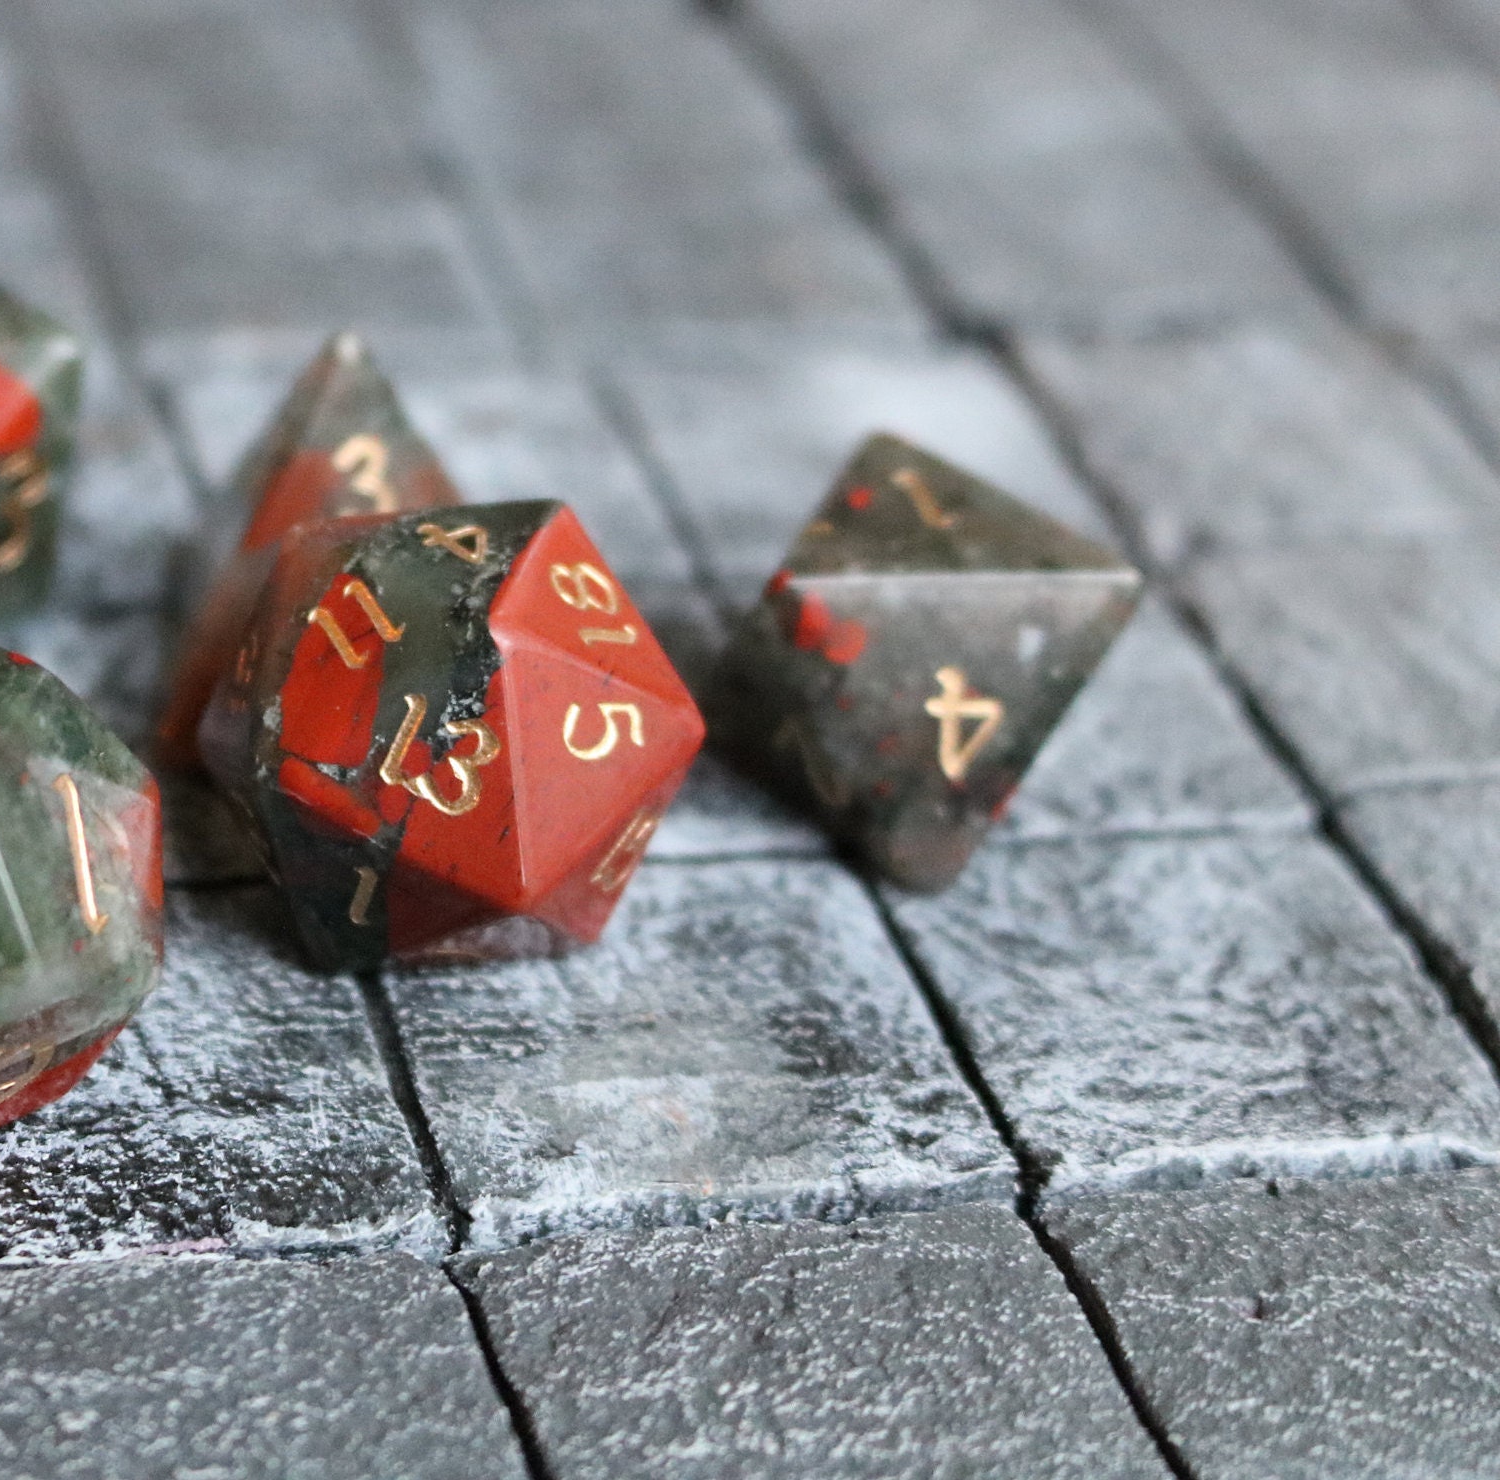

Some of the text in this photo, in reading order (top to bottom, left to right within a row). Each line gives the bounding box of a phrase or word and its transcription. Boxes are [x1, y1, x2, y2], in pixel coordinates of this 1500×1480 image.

[333, 433, 397, 515] 3
[416, 523, 489, 565] 4
[307, 579, 407, 671] 11
[550, 562, 640, 646] 18
[380, 694, 501, 818] 13
[563, 702, 646, 762] 5
[924, 666, 1004, 781] 4
[53, 773, 108, 935] 1
